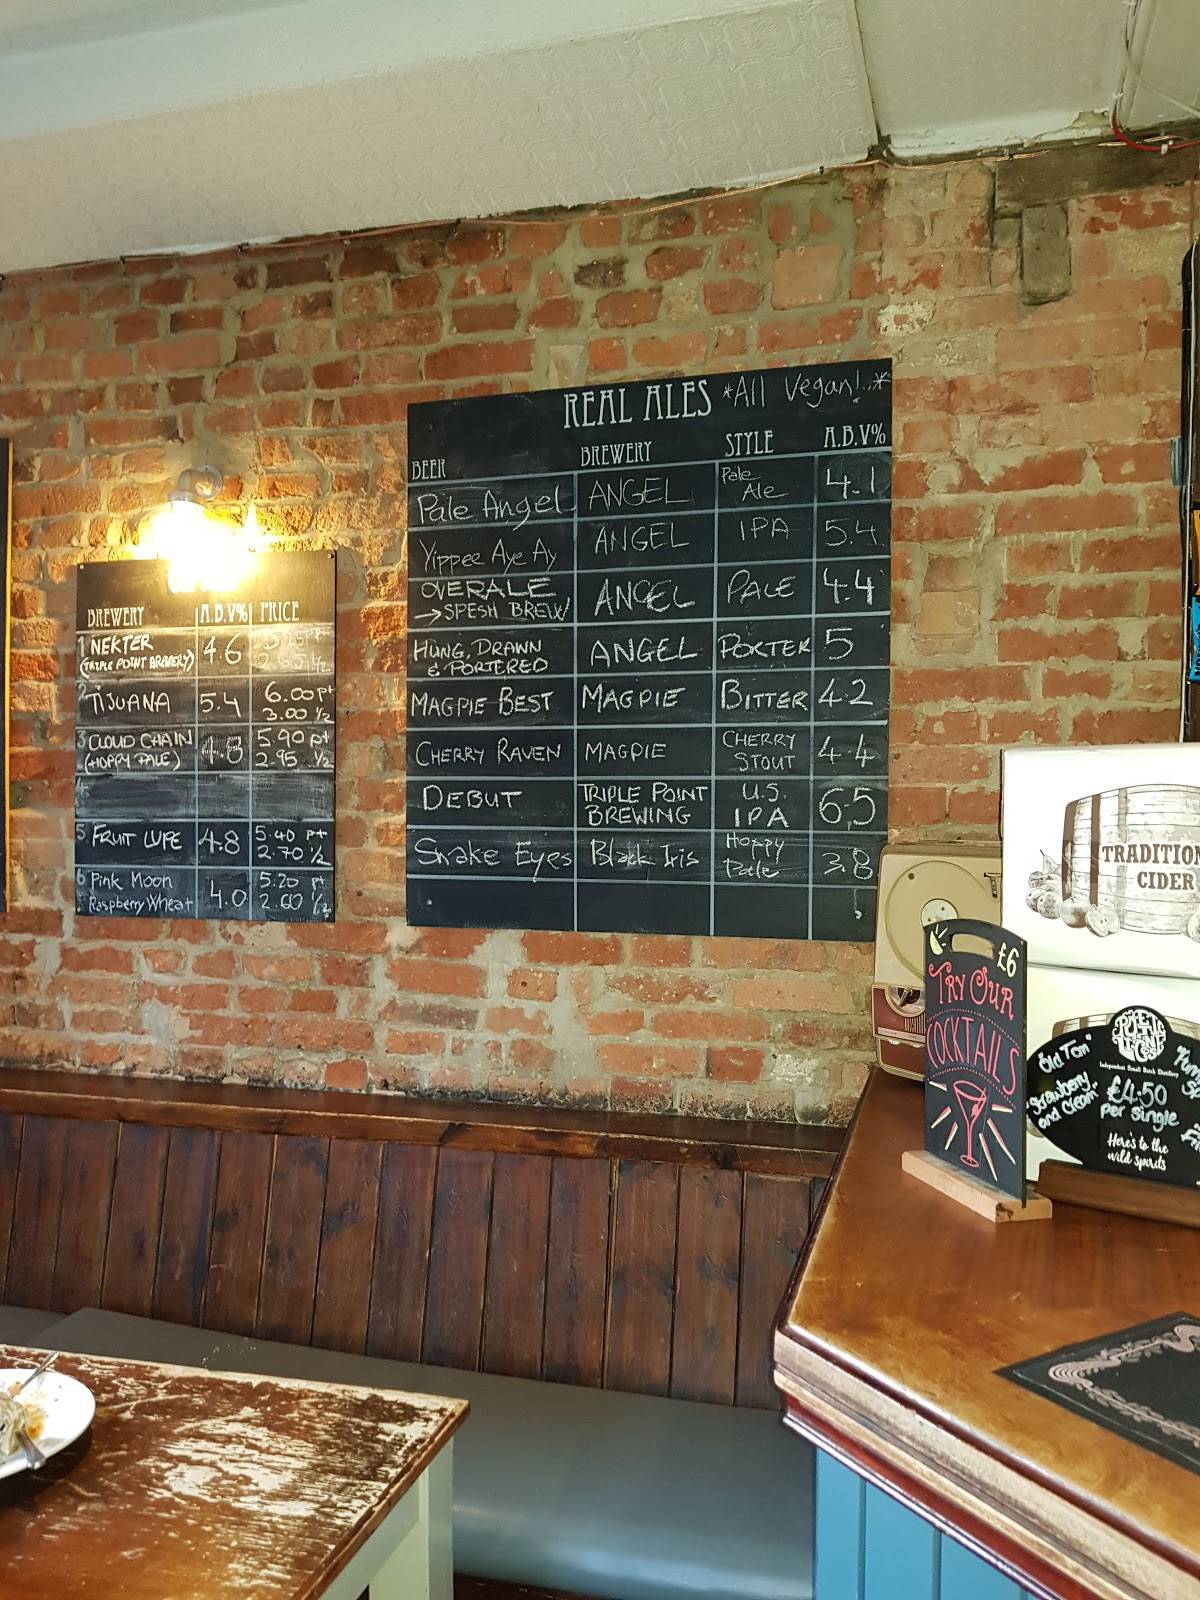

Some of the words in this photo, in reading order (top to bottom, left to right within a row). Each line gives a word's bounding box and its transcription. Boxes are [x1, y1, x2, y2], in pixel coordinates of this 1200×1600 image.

[564, 388, 632, 428] REAL
[643, 380, 712, 421] ALES
[725, 430, 774, 457] STYLE
[824, 423, 886, 447] A.B.V%
[581, 441, 652, 467] BREWERY
[412, 459, 446, 480] BEER
[722, 466, 760, 484] Pale
[589, 477, 690, 511] ANGEL
[742, 482, 788, 501] Ale
[826, 466, 875, 500] 4.1
[418, 494, 473, 524] Pale
[483, 484, 570, 532] Angel
[595, 522, 690, 555] ANGEL
[740, 516, 789, 541] IPA
[825, 518, 878, 546] 5.4
[419, 539, 485, 576] Yippee
[492, 538, 527, 576] Aye
[533, 538, 557, 573] Ay
[421, 577, 556, 600] OVERALE
[594, 578, 696, 616] ANGEL
[727, 569, 796, 604] PALE
[823, 567, 875, 605] 4.4
[87, 606, 144, 628] BREWERY
[260, 600, 300, 622] PRICE
[444, 602, 499, 621] SPESH
[508, 597, 570, 621] BREW
[78, 636, 85, 658] 1
[91, 633, 154, 656] NEKTER
[204, 632, 241, 665] 4.6
[413, 639, 471, 661] HUNG,
[471, 638, 542, 656] DRAWN
[590, 636, 698, 669] ANGEL
[718, 632, 811, 659] PORTER
[825, 628, 853, 660] 5
[116, 656, 147, 670] POINT
[443, 657, 548, 676] PORTERED
[200, 692, 241, 718] 5.4
[265, 681, 314, 703] 6.00
[411, 692, 488, 718] MAGPIE
[499, 686, 554, 716] BEST
[582, 683, 686, 713] MAGPIE
[721, 678, 809, 711] BITTER
[262, 708, 307, 721] 3.00
[89, 734, 135, 751] CLOUD
[140, 730, 192, 748] CHAIN
[257, 728, 304, 748] 5.90
[722, 730, 796, 750] CHERRY
[817, 733, 875, 768] 4.4
[255, 749, 298, 767] 2.95
[415, 741, 484, 767] CHERRY
[497, 737, 561, 764] RAVEN
[585, 742, 667, 763] MAGPIE
[734, 752, 796, 772] STOUT
[423, 784, 523, 811] DEBUT
[578, 783, 641, 803] TRIPLE
[652, 781, 709, 803] POINT
[585, 804, 692, 827] BREWING
[92, 823, 137, 847] FRUIT
[144, 830, 183, 850] LUPE
[199, 827, 240, 855] 4.8
[726, 831, 785, 864] Hoppy
[257, 844, 304, 861] 2.70
[414, 837, 500, 866] Snake
[514, 841, 572, 882] Eyes
[660, 844, 700, 869] Iris
[821, 847, 873, 880] 3.8
[90, 871, 123, 891] Pink
[131, 871, 173, 890] Moon
[723, 857, 779, 879] Pale
[1137, 871, 1194, 890] CIDER
[89, 896, 145, 916] Raspberry
[147, 894, 193, 912] Wheat
[210, 880, 247, 910] 4.0
[997, 942, 1019, 978] £6
[928, 961, 965, 1005] TRY
[969, 966, 1014, 1021] OUR
[927, 1017, 1020, 1096] COCKTAILS
[1100, 1061, 1126, 1070] Independent
[1158, 1069, 1179, 1079] Distillery
[1107, 1075, 1168, 1108] £4.50
[1038, 1106, 1062, 1129] and
[1101, 1102, 1126, 1119] per
[1131, 1105, 1180, 1132] single
[1107, 1130, 1136, 1149] Here's
[1139, 1136, 1149, 1151] to
[1151, 1138, 1169, 1154] the
[1107, 1149, 1132, 1164] wild
[1134, 1155, 1167, 1171] spirits
